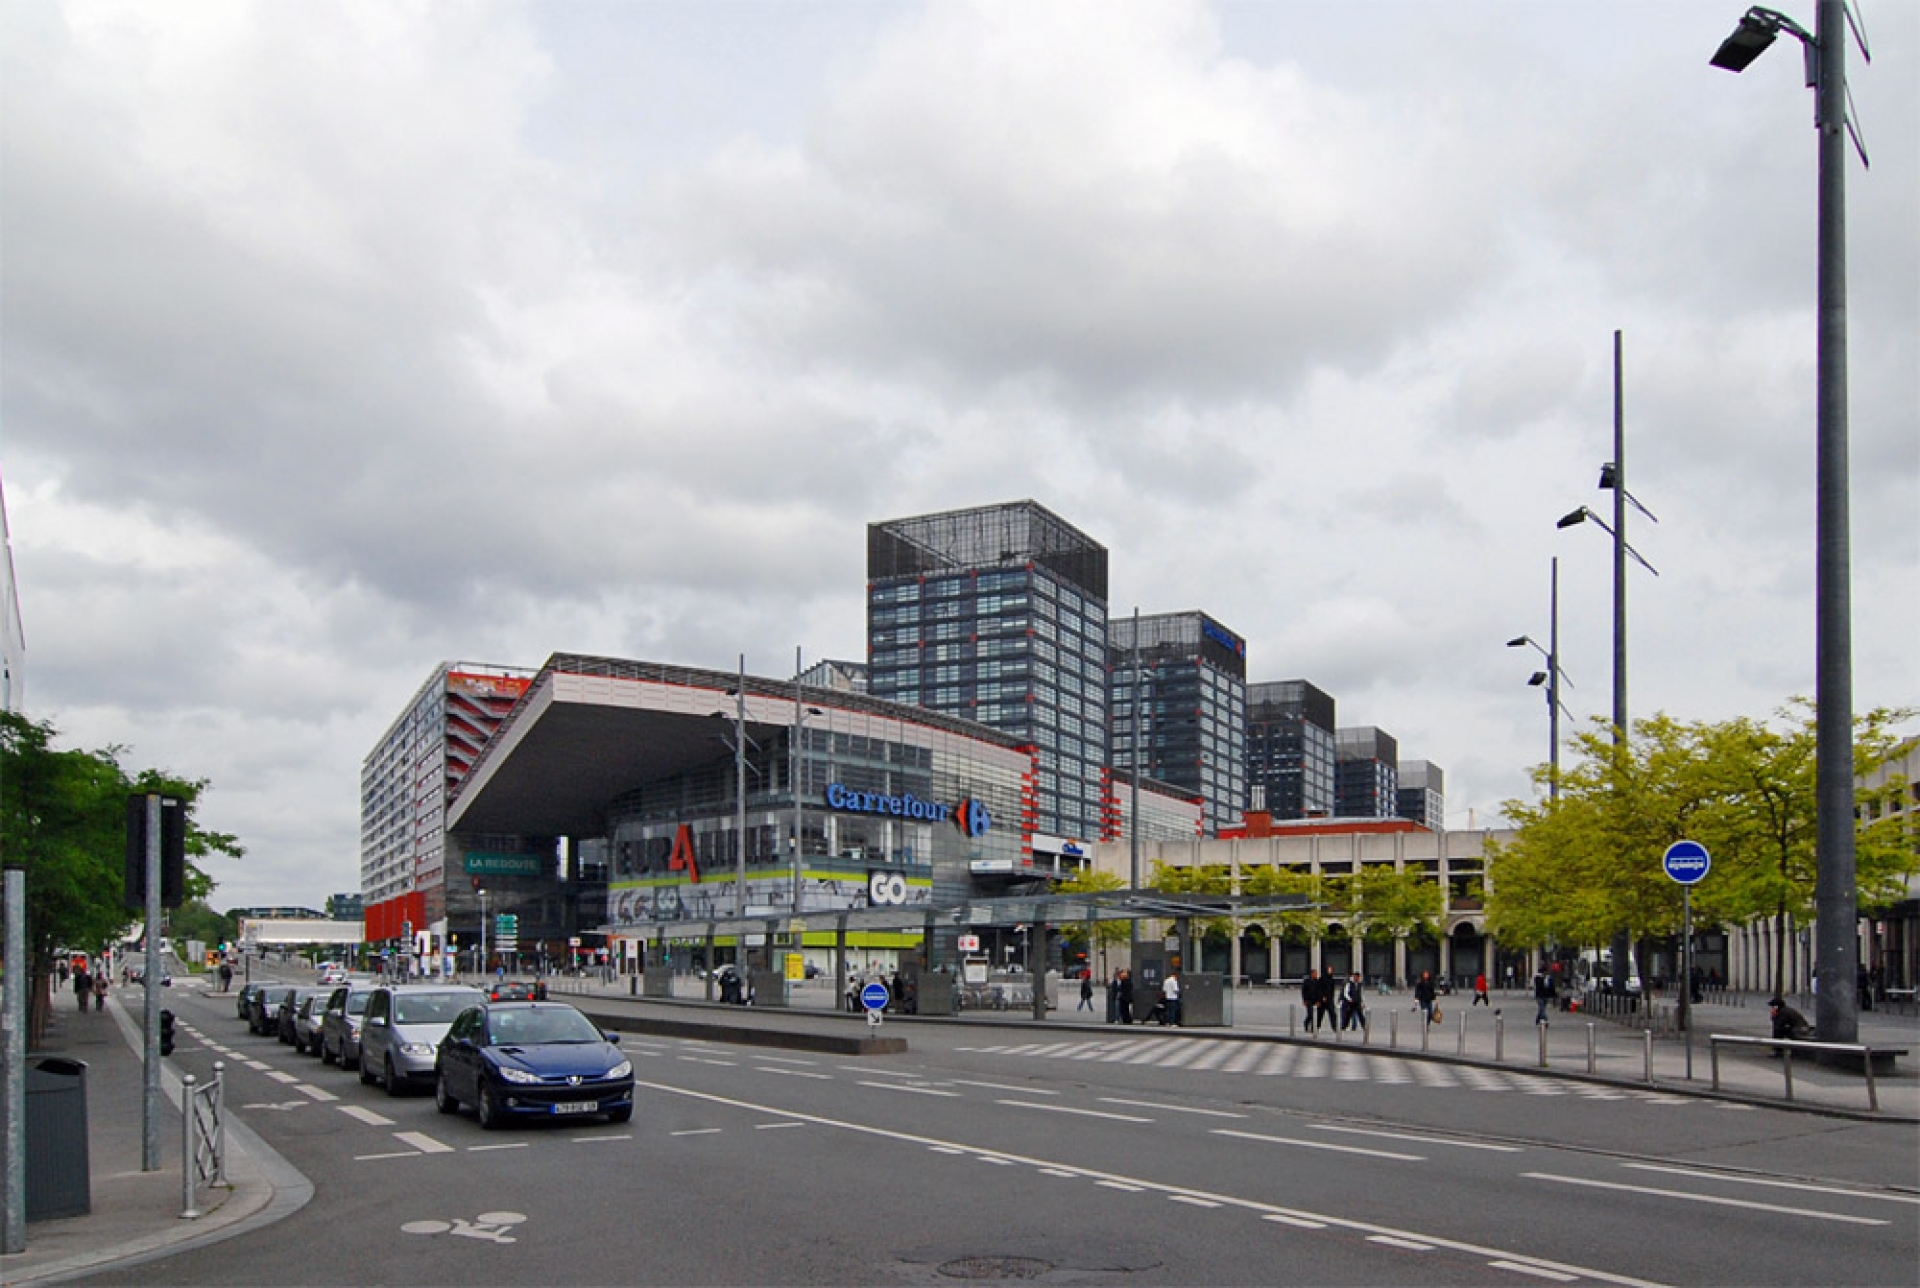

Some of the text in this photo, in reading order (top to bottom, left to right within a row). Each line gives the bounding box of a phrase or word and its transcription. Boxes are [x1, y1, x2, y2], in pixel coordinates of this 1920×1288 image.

[827, 782, 948, 822] Carrefour
[469, 858, 538, 870] LA REDOUTE
[870, 872, 907, 905] GO
